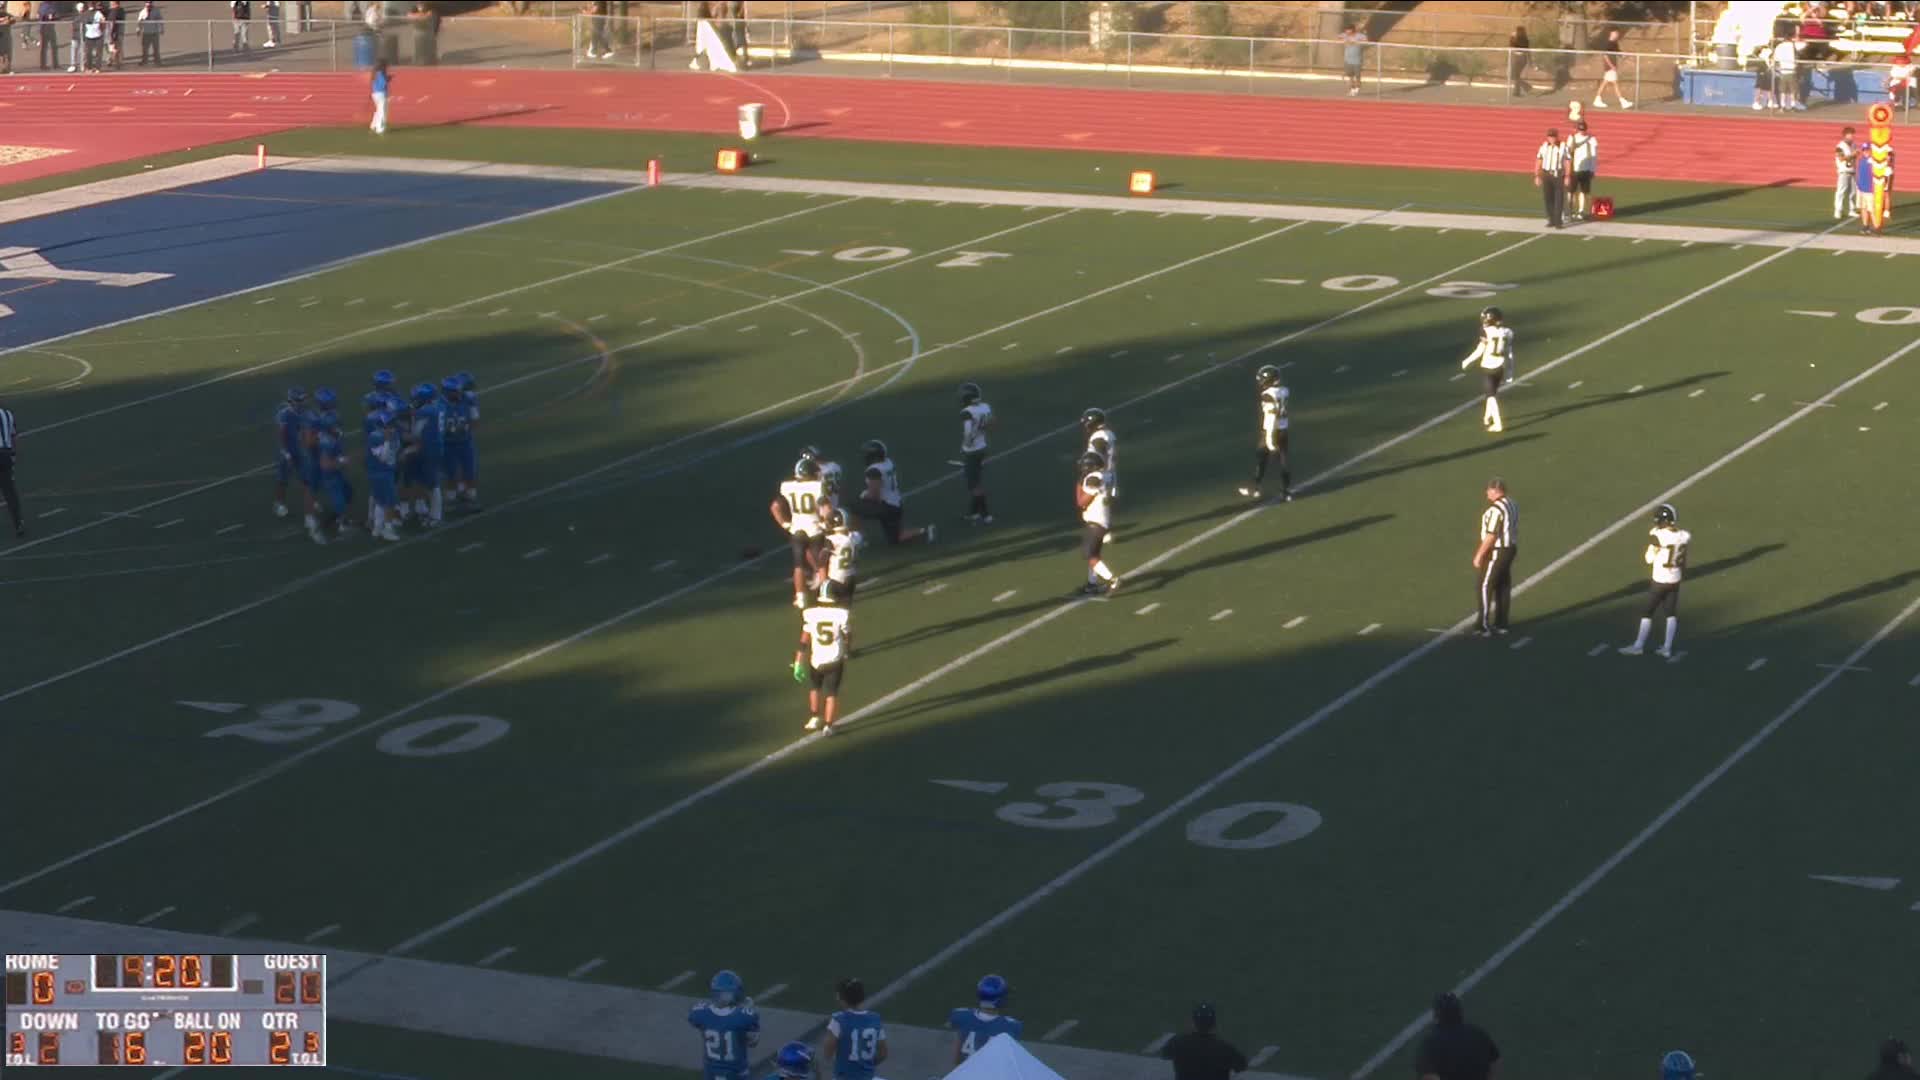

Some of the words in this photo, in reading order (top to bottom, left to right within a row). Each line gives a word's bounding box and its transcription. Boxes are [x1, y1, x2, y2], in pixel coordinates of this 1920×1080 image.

[789, 492, 816, 515] 10
[816, 621, 834, 646] 5
[705, 1030, 735, 1060] 21
[848, 1028, 877, 1061] 13
